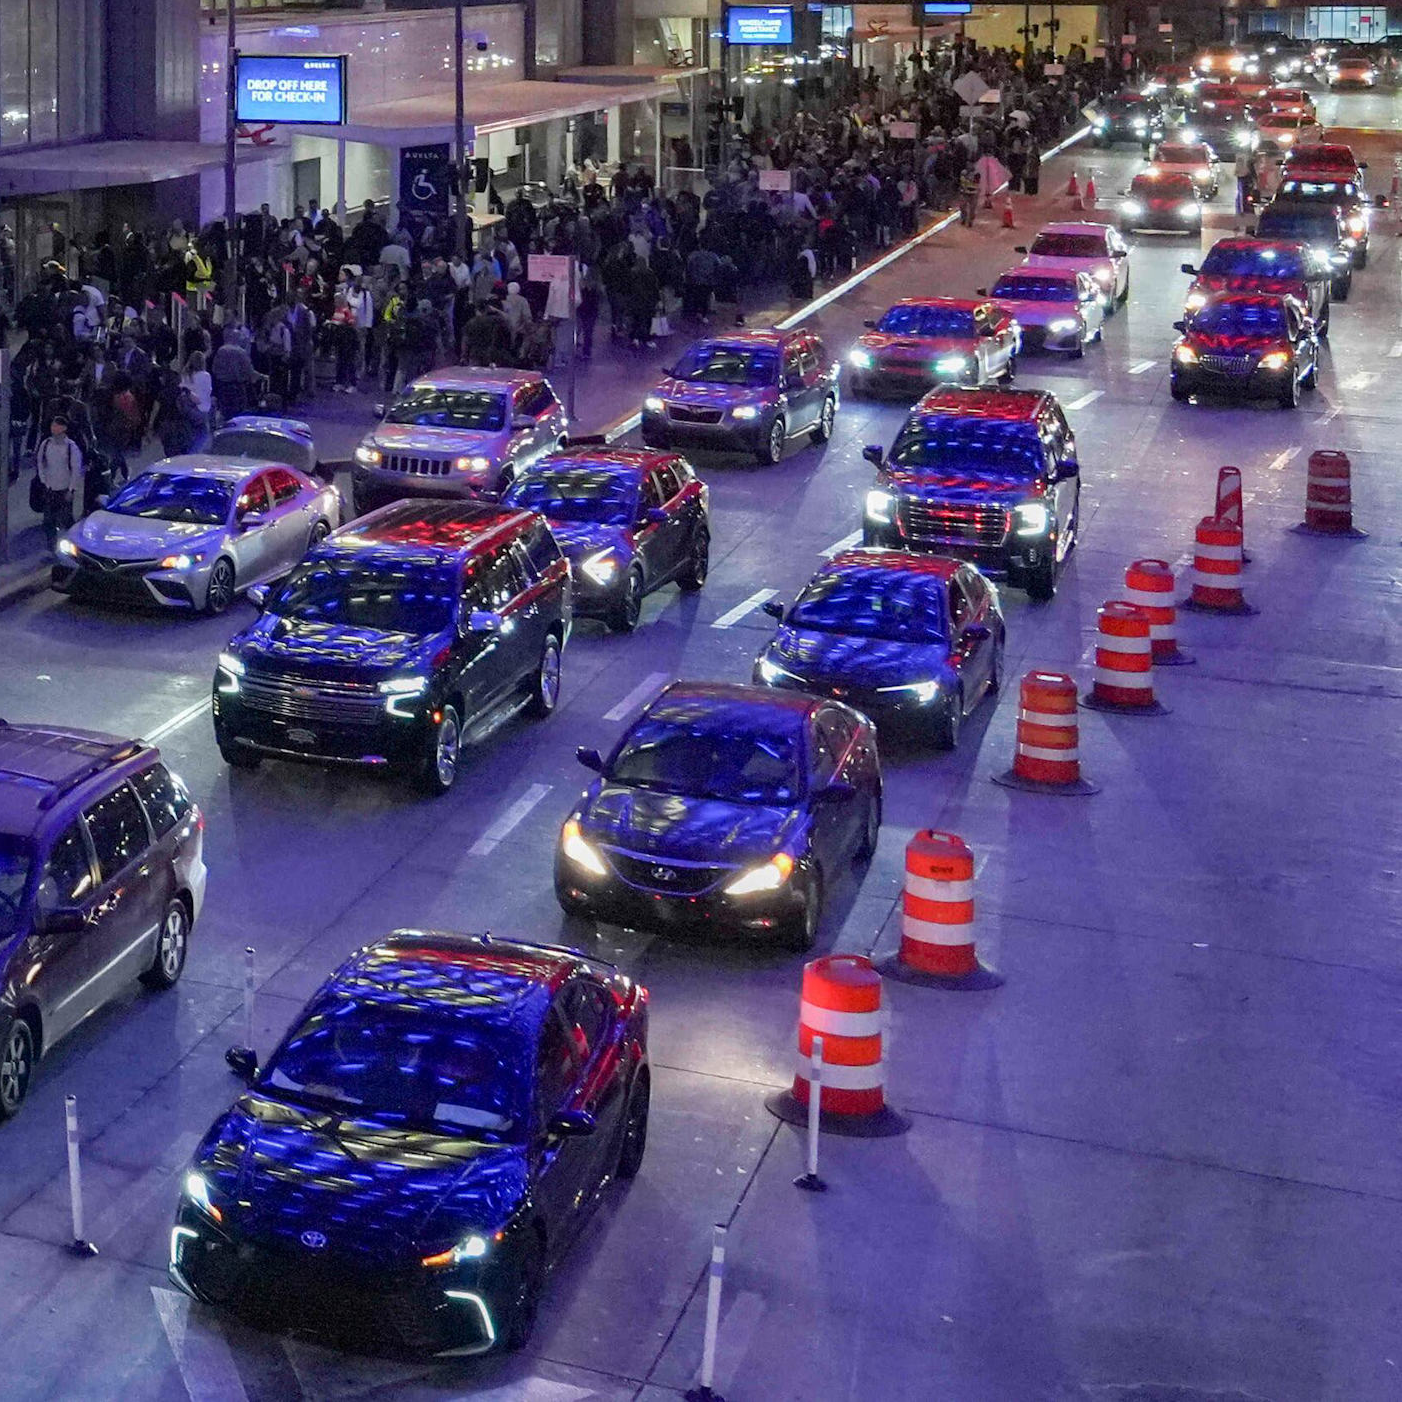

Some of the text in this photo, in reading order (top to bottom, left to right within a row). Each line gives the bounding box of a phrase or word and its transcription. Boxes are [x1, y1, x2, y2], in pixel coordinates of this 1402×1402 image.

[247, 78, 328, 92] DROP OFF HERE
[251, 90, 326, 103] FOR CHECK-IN
